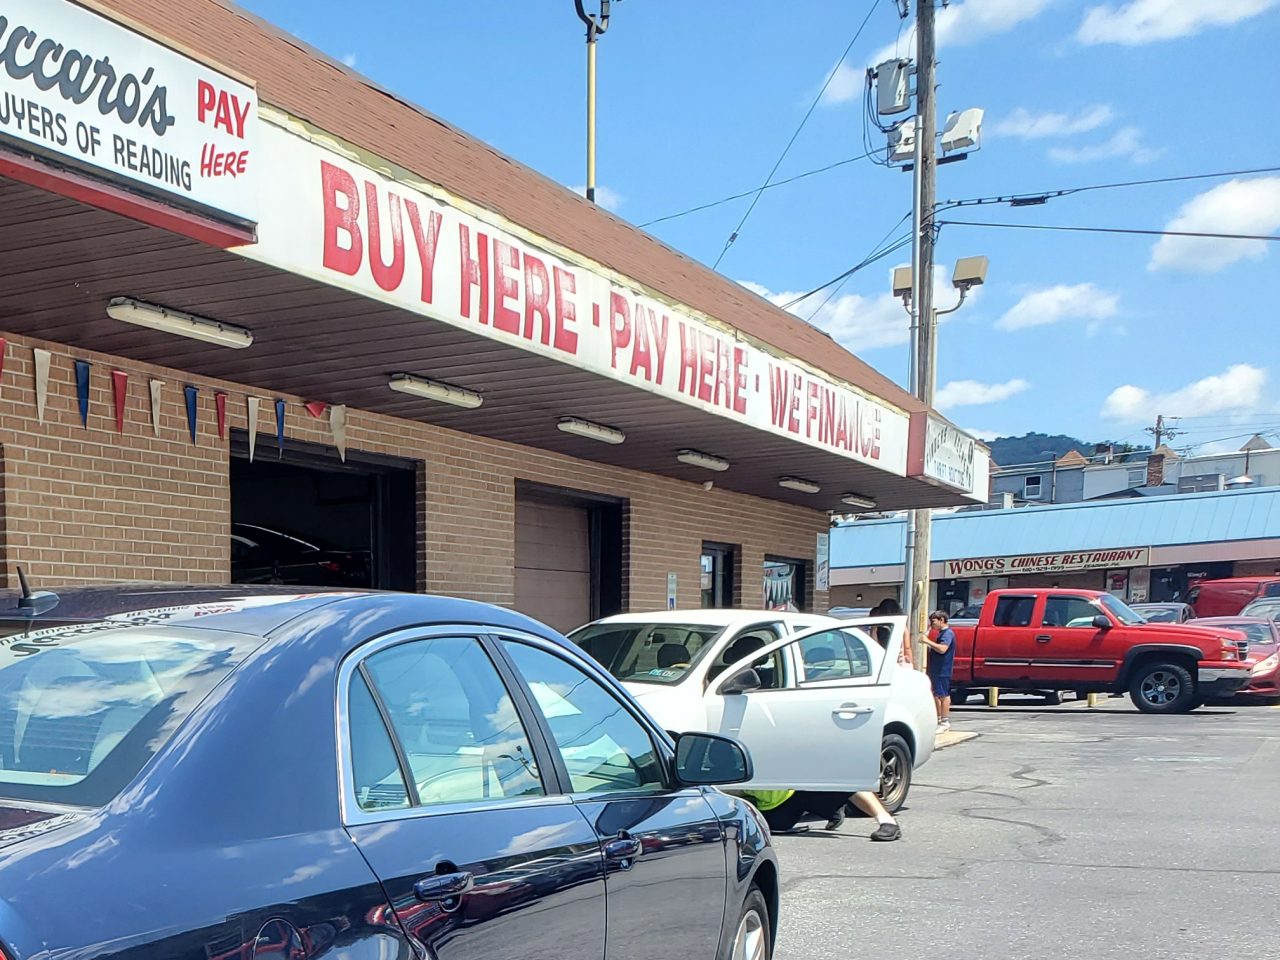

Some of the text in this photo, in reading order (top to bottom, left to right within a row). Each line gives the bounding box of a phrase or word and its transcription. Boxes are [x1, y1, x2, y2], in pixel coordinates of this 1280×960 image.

[197, 78, 251, 140] PAY
[75, 121, 101, 157] OF
[113, 133, 192, 192] READING
[200, 143, 249, 179] HERE
[320, 160, 882, 461] BUY HERE PAY HERE WE FINANCE
[948, 549, 1145, 575] WONG'S CHINESE RESTAURANT
